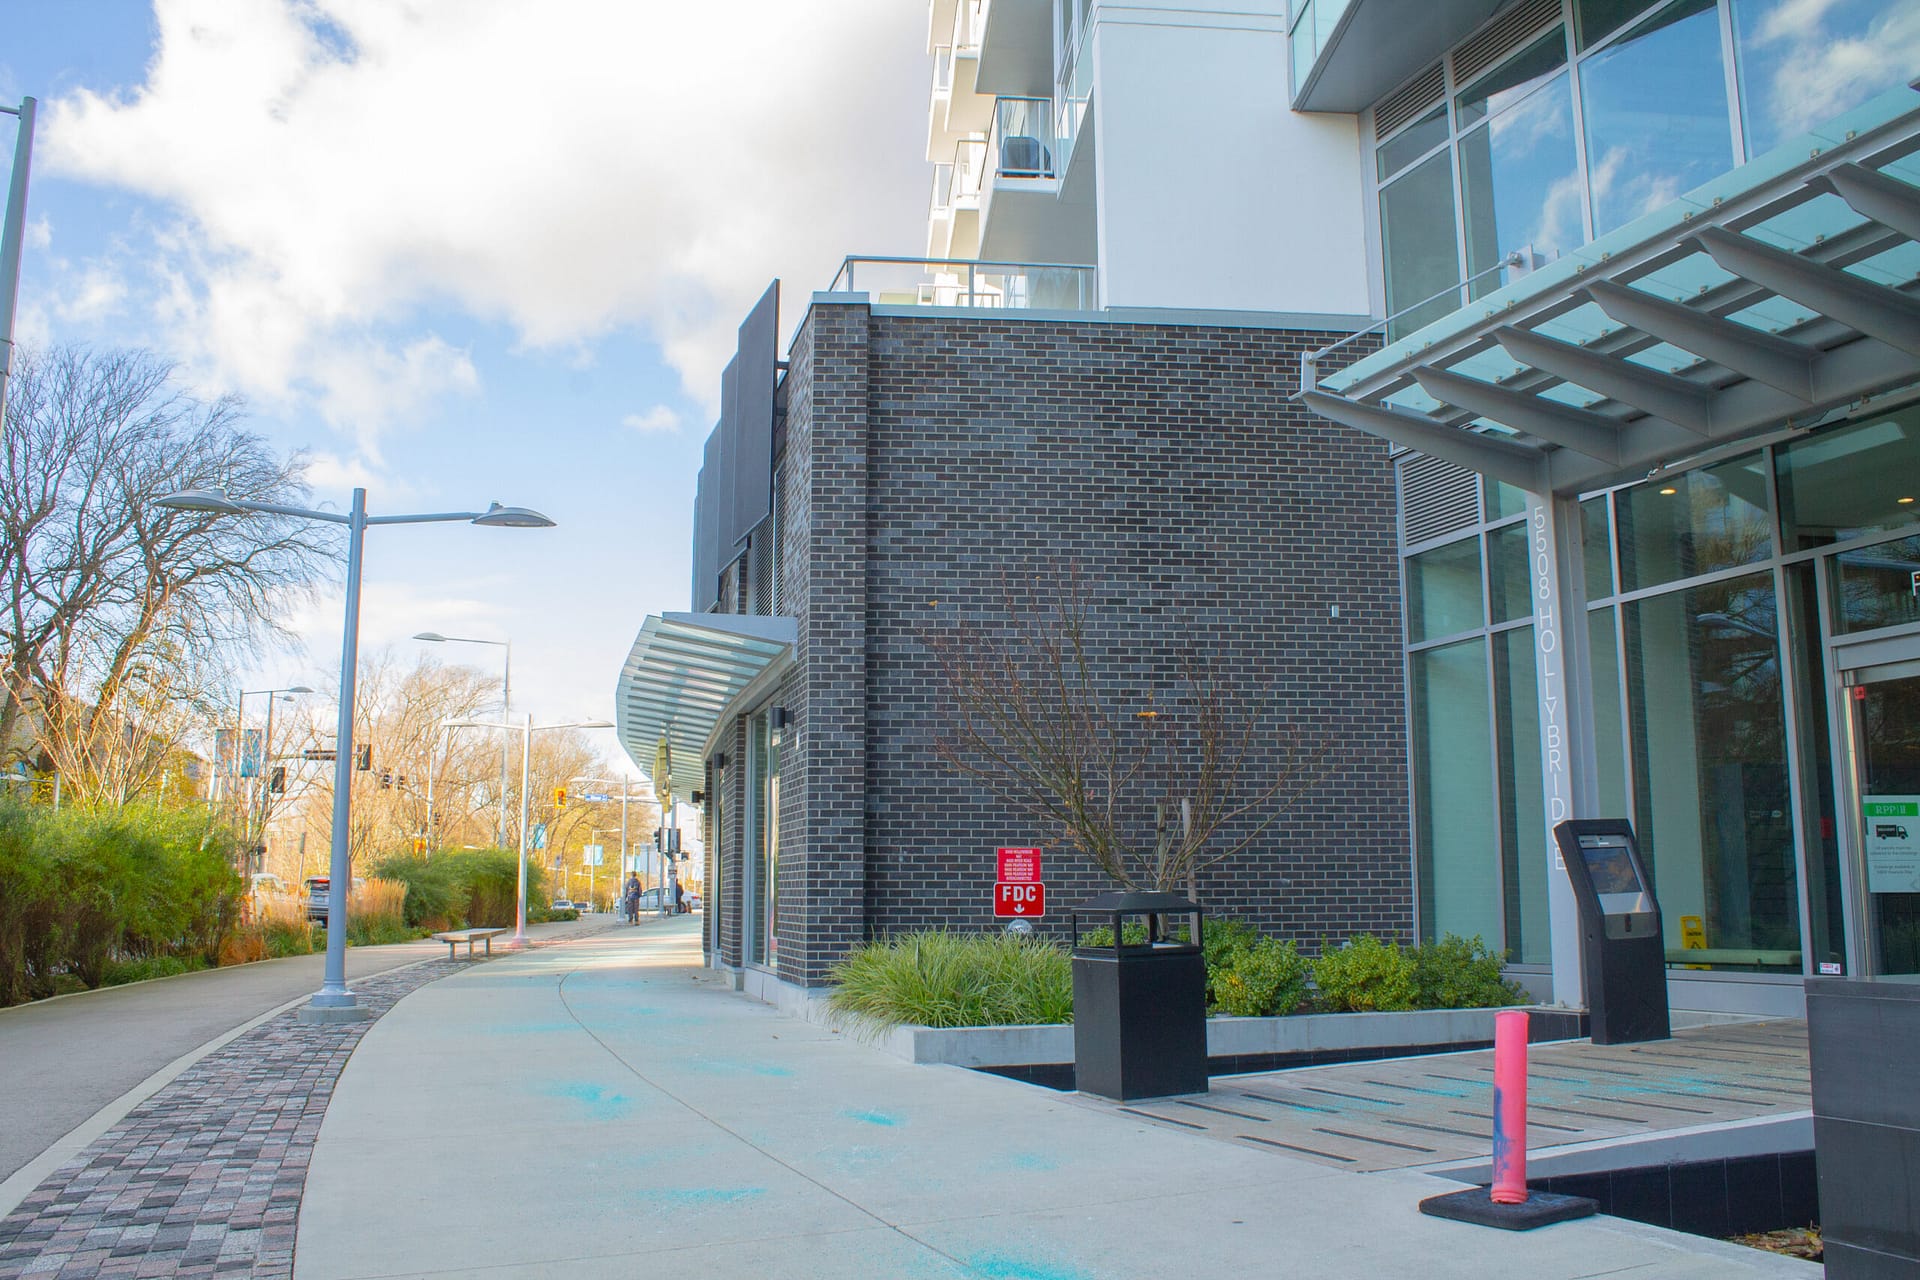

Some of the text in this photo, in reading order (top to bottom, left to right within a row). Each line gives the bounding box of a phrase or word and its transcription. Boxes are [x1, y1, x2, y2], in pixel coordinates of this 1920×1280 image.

[1533, 506, 1567, 870] 5508 HOLLYBRIDE
[1002, 885, 1036, 902] FDC
